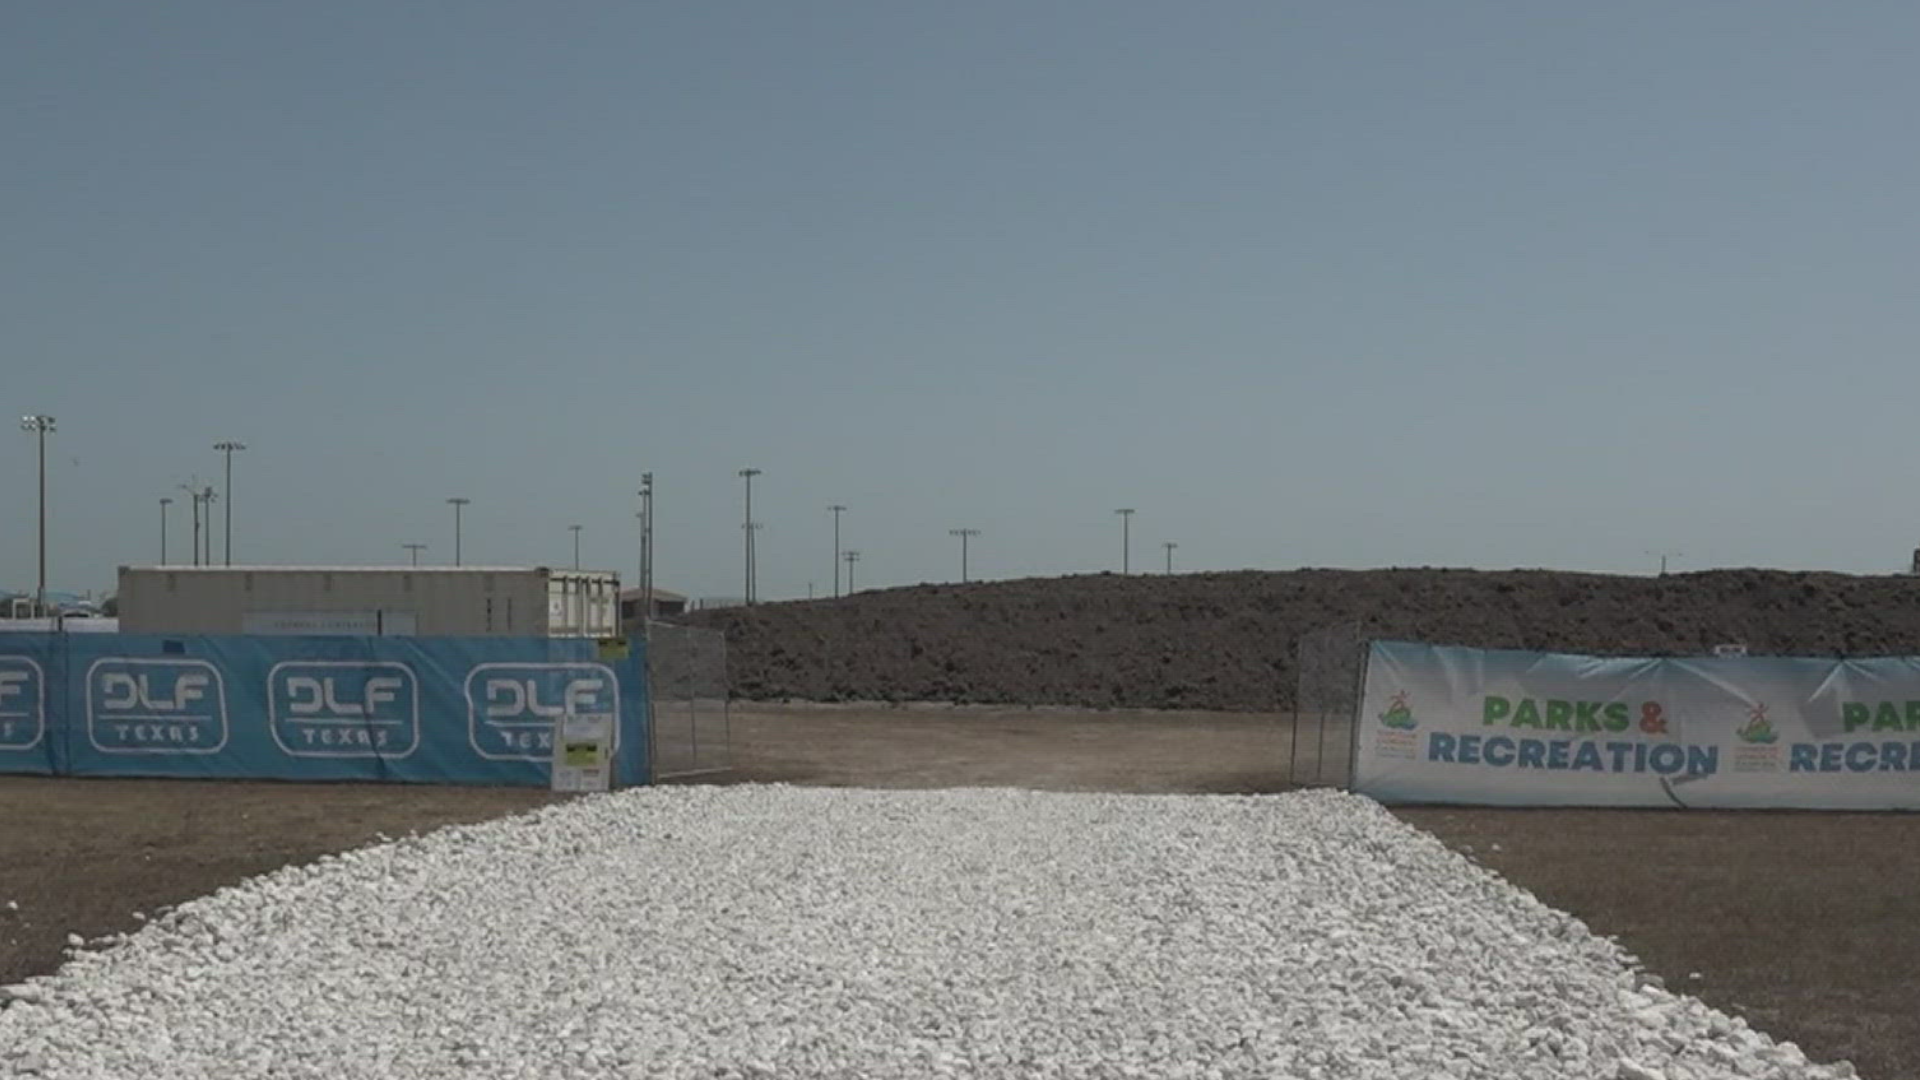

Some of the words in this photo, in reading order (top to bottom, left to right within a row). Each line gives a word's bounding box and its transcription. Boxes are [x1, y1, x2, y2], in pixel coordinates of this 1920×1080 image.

[102, 673, 209, 710] DLF
[286, 677, 403, 714] DLF
[486, 679, 604, 716] DLF
[114, 723, 200, 742] TEXAS
[1482, 696, 1631, 733] PARKS
[1638, 701, 1669, 735] &
[302, 728, 388, 746] TEXAS
[500, 730, 552, 748] TEX
[1427, 731, 1719, 776] RECREATION
